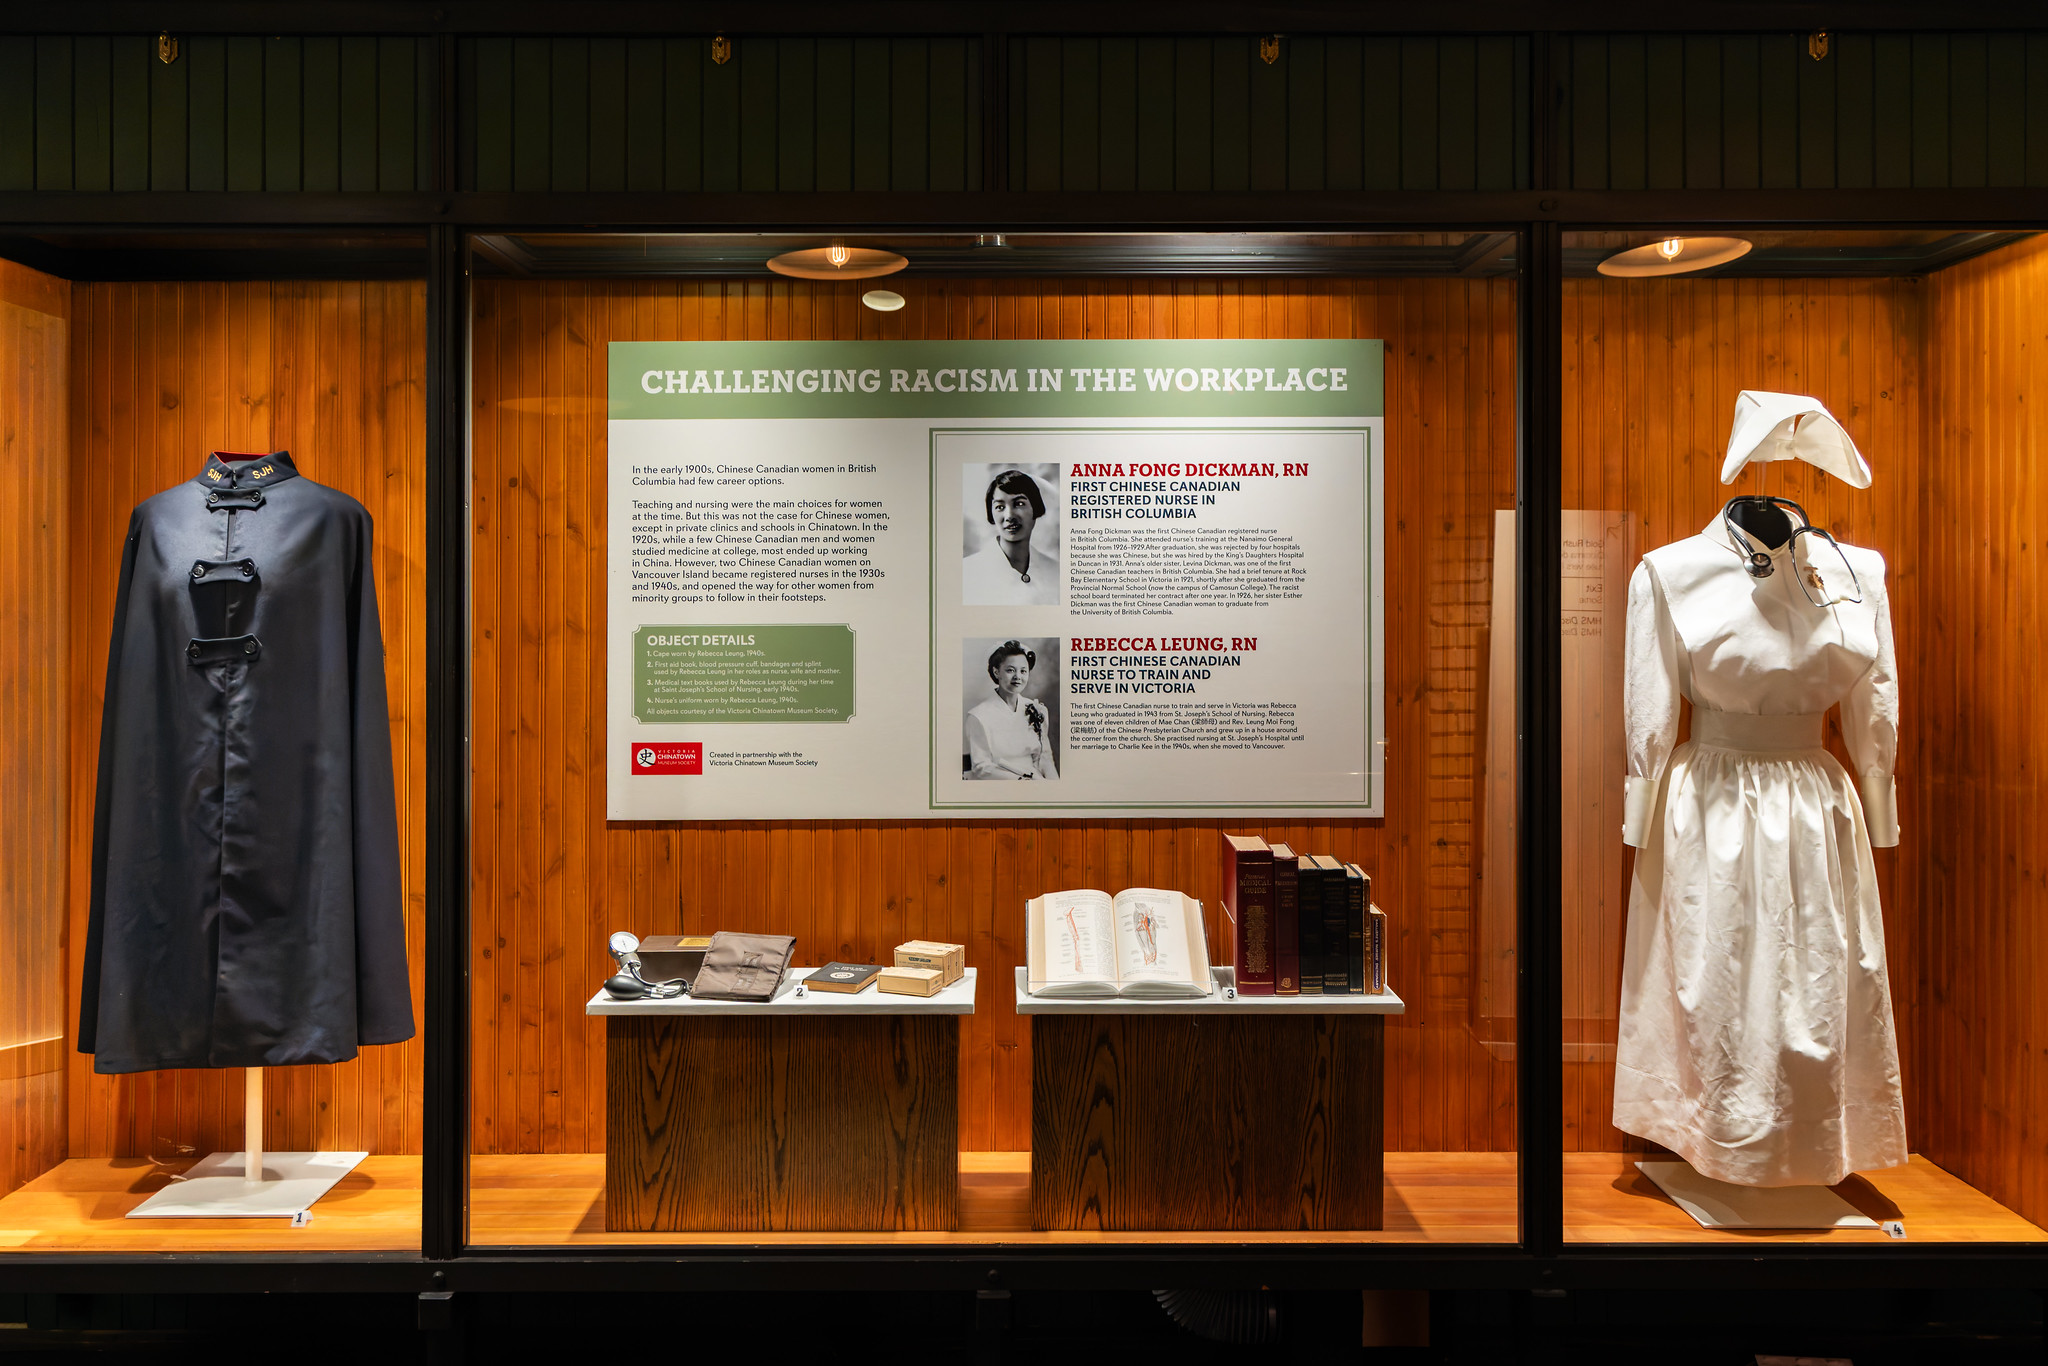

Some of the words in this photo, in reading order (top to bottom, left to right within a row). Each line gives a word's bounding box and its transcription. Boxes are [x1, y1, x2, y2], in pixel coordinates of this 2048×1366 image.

[641, 369, 881, 394] CHALLENGING
[890, 369, 1019, 393] RACISM
[1027, 368, 1063, 392] IN
[1071, 368, 1136, 392] THE
[1143, 368, 1348, 392] WORKPLACE
[207, 468, 223, 482] SJH
[252, 465, 274, 480] SJH
[633, 465, 641, 474] In
[644, 465, 658, 474] the
[661, 465, 683, 476] early
[685, 465, 714, 475] 1900s,
[717, 465, 753, 473] Chinese
[756, 465, 799, 473] Canadian
[837, 464, 845, 473] in
[848, 464, 876, 473] British
[1070, 463, 1125, 477] ANNA
[1129, 463, 1180, 477] FONG
[1185, 463, 1279, 479] DICKMAN,
[1282, 463, 1309, 476] RN
[1071, 481, 1107, 492] FIRST
[1109, 481, 1166, 492] CHINESE
[1170, 481, 1240, 492] CANADIAN
[632, 500, 673, 511] Teaching
[675, 500, 692, 508] and
[695, 500, 728, 511] nursing
[756, 500, 770, 508] the
[773, 499, 794, 508] main
[797, 499, 832, 508] choices
[834, 499, 848, 508] for
[1071, 495, 1151, 505] REGISTERED
[1155, 495, 1198, 505] NURSE
[1202, 495, 1215, 505] IN
[1071, 508, 1121, 519] BRITISH
[1125, 508, 1196, 519] COLUMBIA
[1088, 528, 1103, 536] Fong
[1228, 528, 1259, 536] registered
[632, 570, 680, 579] Vancouver
[683, 570, 709, 578] Island
[712, 570, 748, 578] became
[751, 570, 796, 581] registered
[831, 569, 839, 578] in
[842, 569, 857, 578] the
[859, 569, 885, 578] 1930s
[632, 593, 669, 604] minority
[671, 595, 703, 604] groups
[706, 593, 715, 602] to
[718, 593, 745, 602] follow
[747, 593, 755, 602] in
[758, 593, 779, 601] their
[781, 593, 826, 604] footsteps.
[1082, 609, 1113, 617] University
[647, 635, 699, 646] OBJECT
[702, 635, 755, 645] DETAILS
[1071, 638, 1157, 651] REBECCA
[1161, 638, 1227, 653] LEUNG,
[1231, 638, 1257, 651] RN
[688, 650, 696, 658] by
[760, 661, 790, 669] bandages
[805, 661, 821, 669] splint
[1071, 656, 1107, 667] FIRST
[1109, 656, 1167, 666] CHINESE
[1170, 656, 1240, 666] CANADIAN
[1071, 670, 1114, 680] NURSE
[1117, 670, 1136, 680] TO
[1138, 670, 1179, 680] TRAIN
[1182, 670, 1211, 680] AND
[1071, 683, 1111, 694] SERVE
[1115, 683, 1128, 694] IN
[1131, 683, 1195, 693] VICTORIA
[656, 708, 679, 716] objects
[680, 708, 707, 716] courtesy
[1071, 711, 1089, 719] Leung
[1105, 711, 1136, 719] graduated
[639, 749, 655, 765] 史
[742, 751, 777, 759] partnership
[795, 759, 818, 767] Society
[795, 988, 804, 997] 2
[1227, 989, 1234, 999] 3
[296, 1212, 302, 1222] 1
[1894, 1224, 1902, 1234] 4
